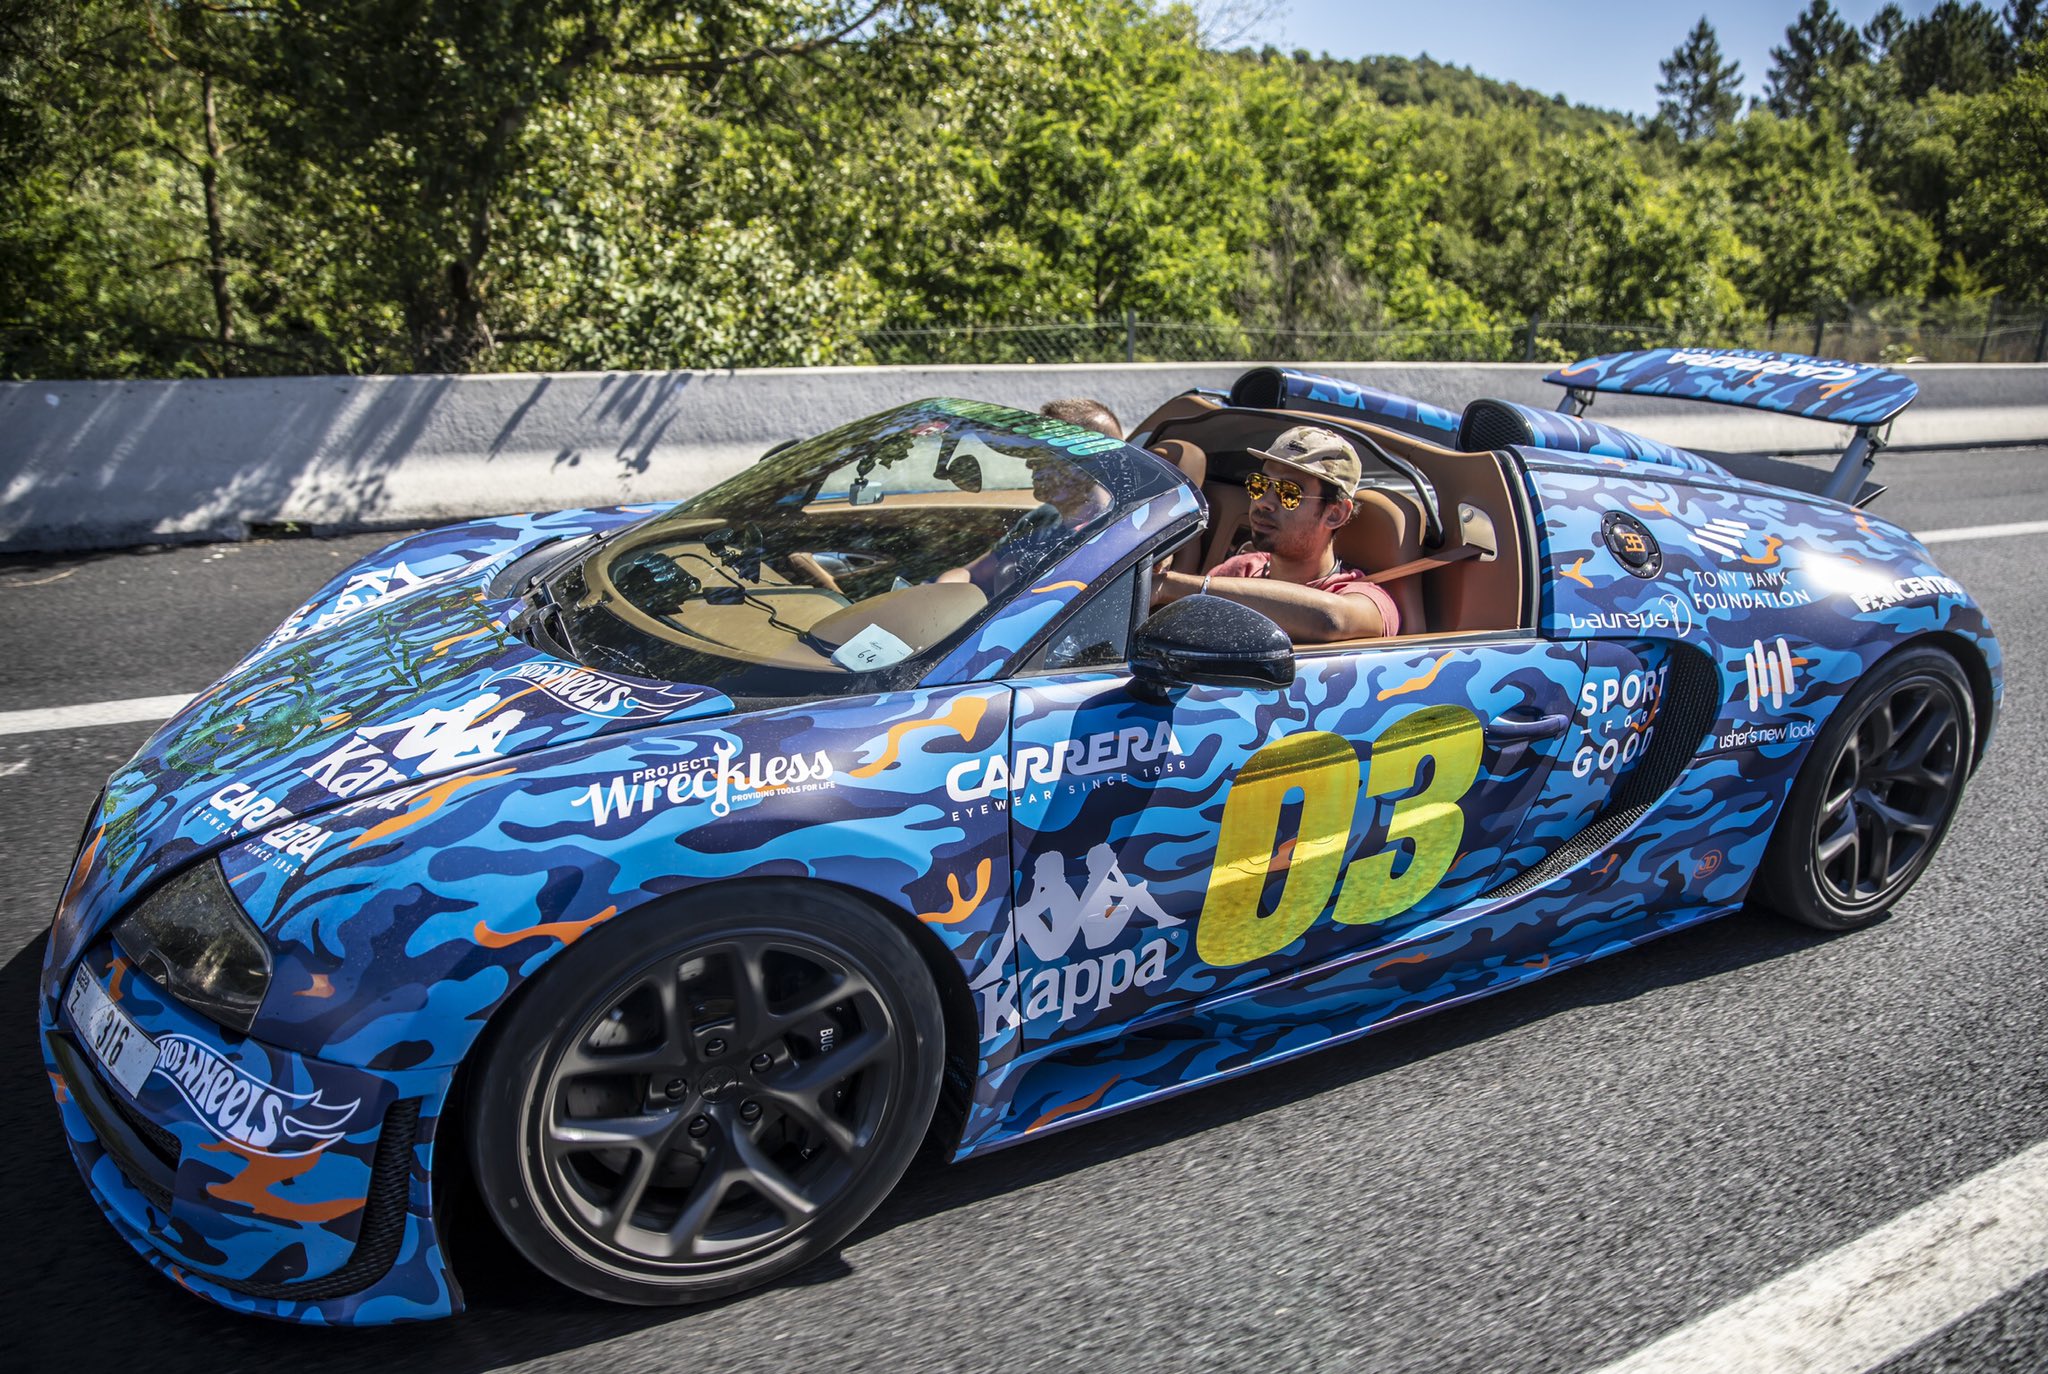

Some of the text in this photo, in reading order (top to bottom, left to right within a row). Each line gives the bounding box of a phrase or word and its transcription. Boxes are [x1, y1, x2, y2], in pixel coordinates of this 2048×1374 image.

[1694, 571, 1791, 588] TONY HAWK
[1694, 589, 1811, 609] FOUNDATION
[1581, 666, 1667, 717] SPORT
[1604, 710, 1648, 734] FOR
[1719, 721, 1816, 749] usher's new look
[633, 756, 711, 784] PROJECT
[946, 720, 1184, 803] CARRERA
[1572, 727, 1654, 778] GOOD
[571, 741, 834, 827] Wreckless
[731, 780, 836, 803] PROVIDING TOOLS FOR LIFE
[952, 760, 1187, 822] EYEWEAR SINCE 1956
[1196, 704, 1484, 967] 03
[243, 843, 273, 862] SINCE
[272, 858, 300, 877] 1956
[979, 938, 1168, 1044] Kappa
